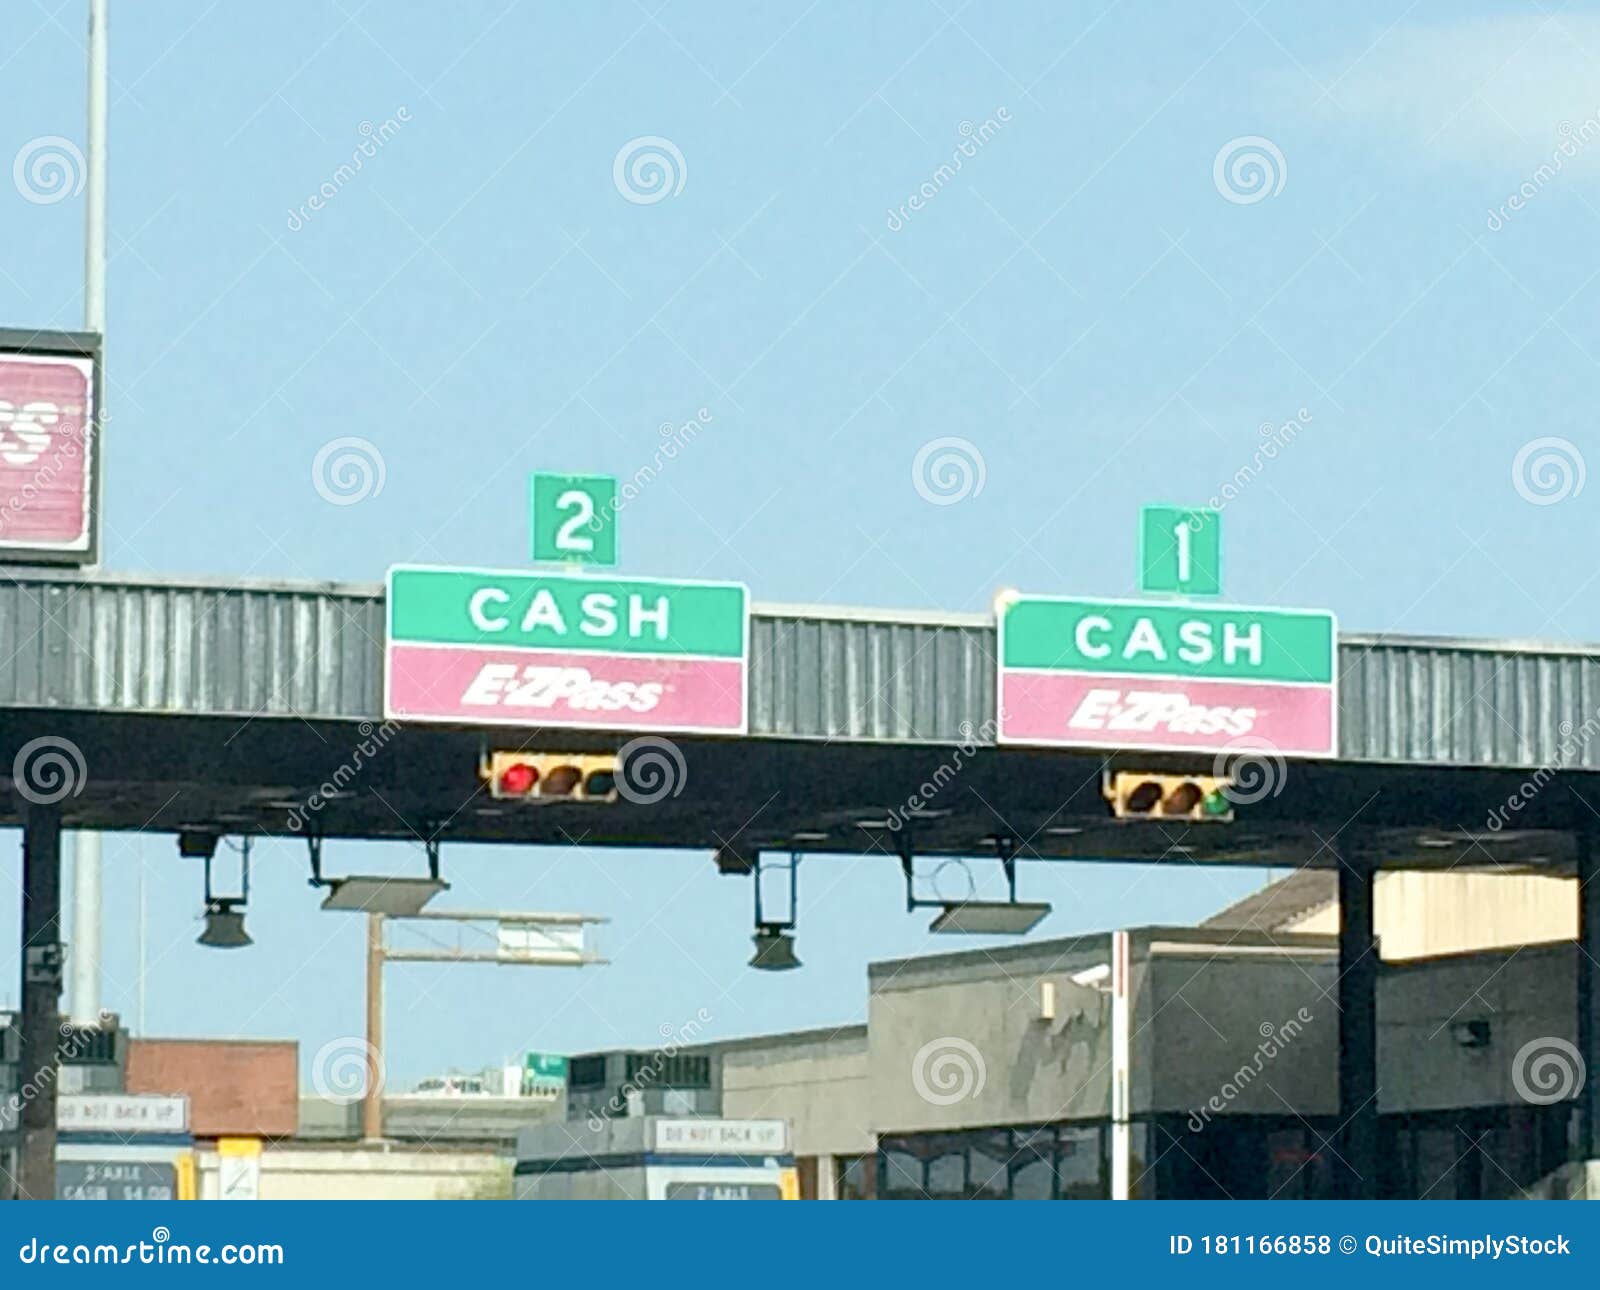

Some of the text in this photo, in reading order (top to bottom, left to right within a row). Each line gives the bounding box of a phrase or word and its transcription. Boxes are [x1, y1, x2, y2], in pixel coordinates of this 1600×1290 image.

[555, 489, 594, 552] 2
[1173, 521, 1191, 583] 1
[469, 587, 670, 641] CASH
[1075, 615, 1263, 666] CASH
